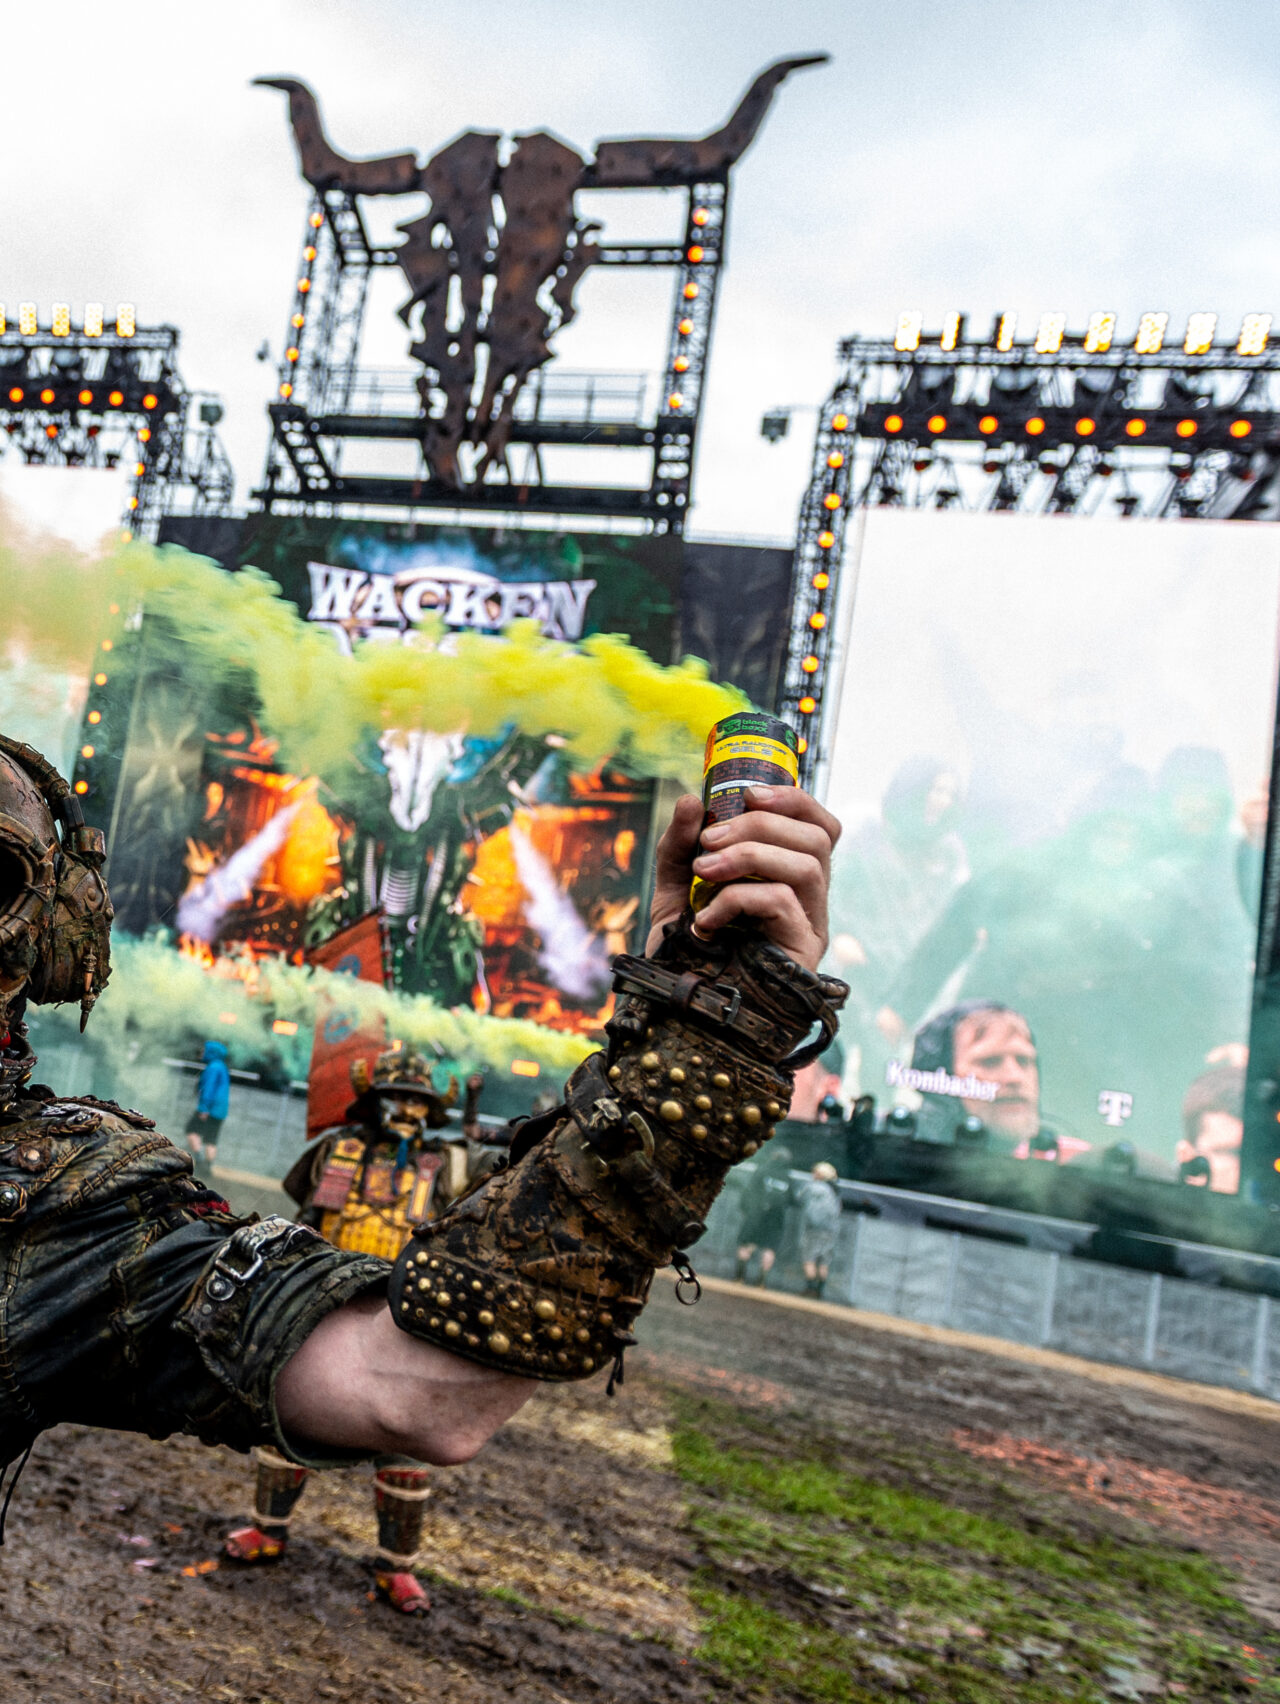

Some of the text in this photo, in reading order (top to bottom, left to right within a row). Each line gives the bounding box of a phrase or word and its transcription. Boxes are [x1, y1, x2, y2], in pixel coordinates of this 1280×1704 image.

[306, 561, 598, 641] WACKEN
[742, 719, 768, 727] black
[742, 725, 768, 733] boxx
[710, 791, 723, 799] NUR
[886, 1061, 1000, 1102] Krombacher
